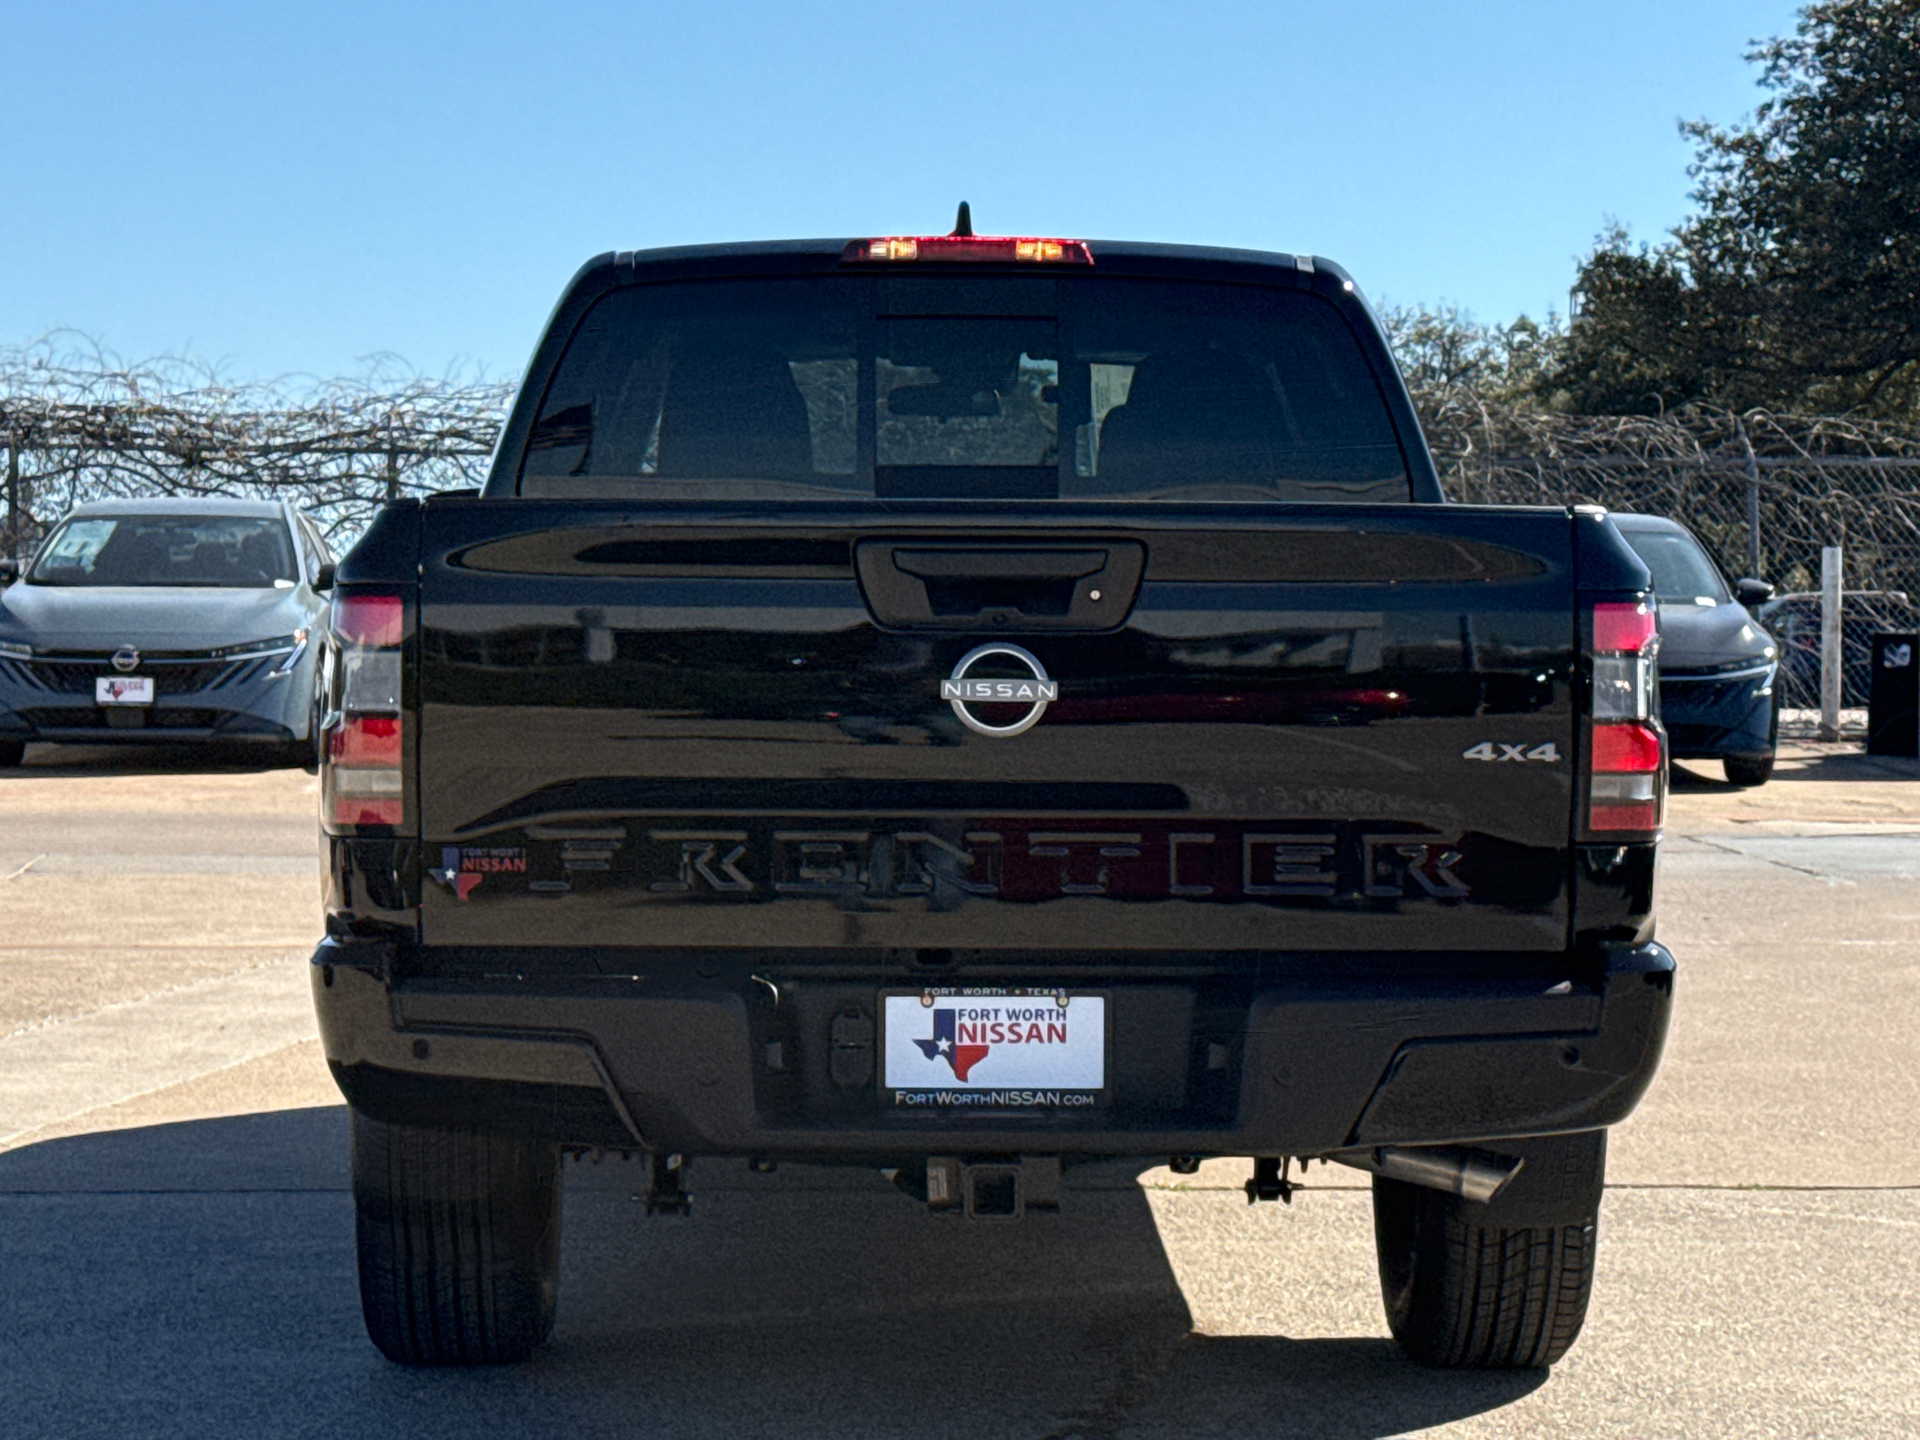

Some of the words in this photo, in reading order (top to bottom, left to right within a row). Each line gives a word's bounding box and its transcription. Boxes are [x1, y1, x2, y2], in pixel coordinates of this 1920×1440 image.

[945, 682, 1055, 698] NISSAN
[462, 847, 489, 857] FORT
[462, 857, 527, 873] NISSAN
[924, 987, 957, 996] FORT
[962, 987, 1007, 996] WORTH
[1027, 987, 1066, 996] TEXAS
[958, 1008, 1001, 1021] FORT
[1006, 1008, 1067, 1021] WORTH
[958, 1022, 1067, 1045] NISSAN
